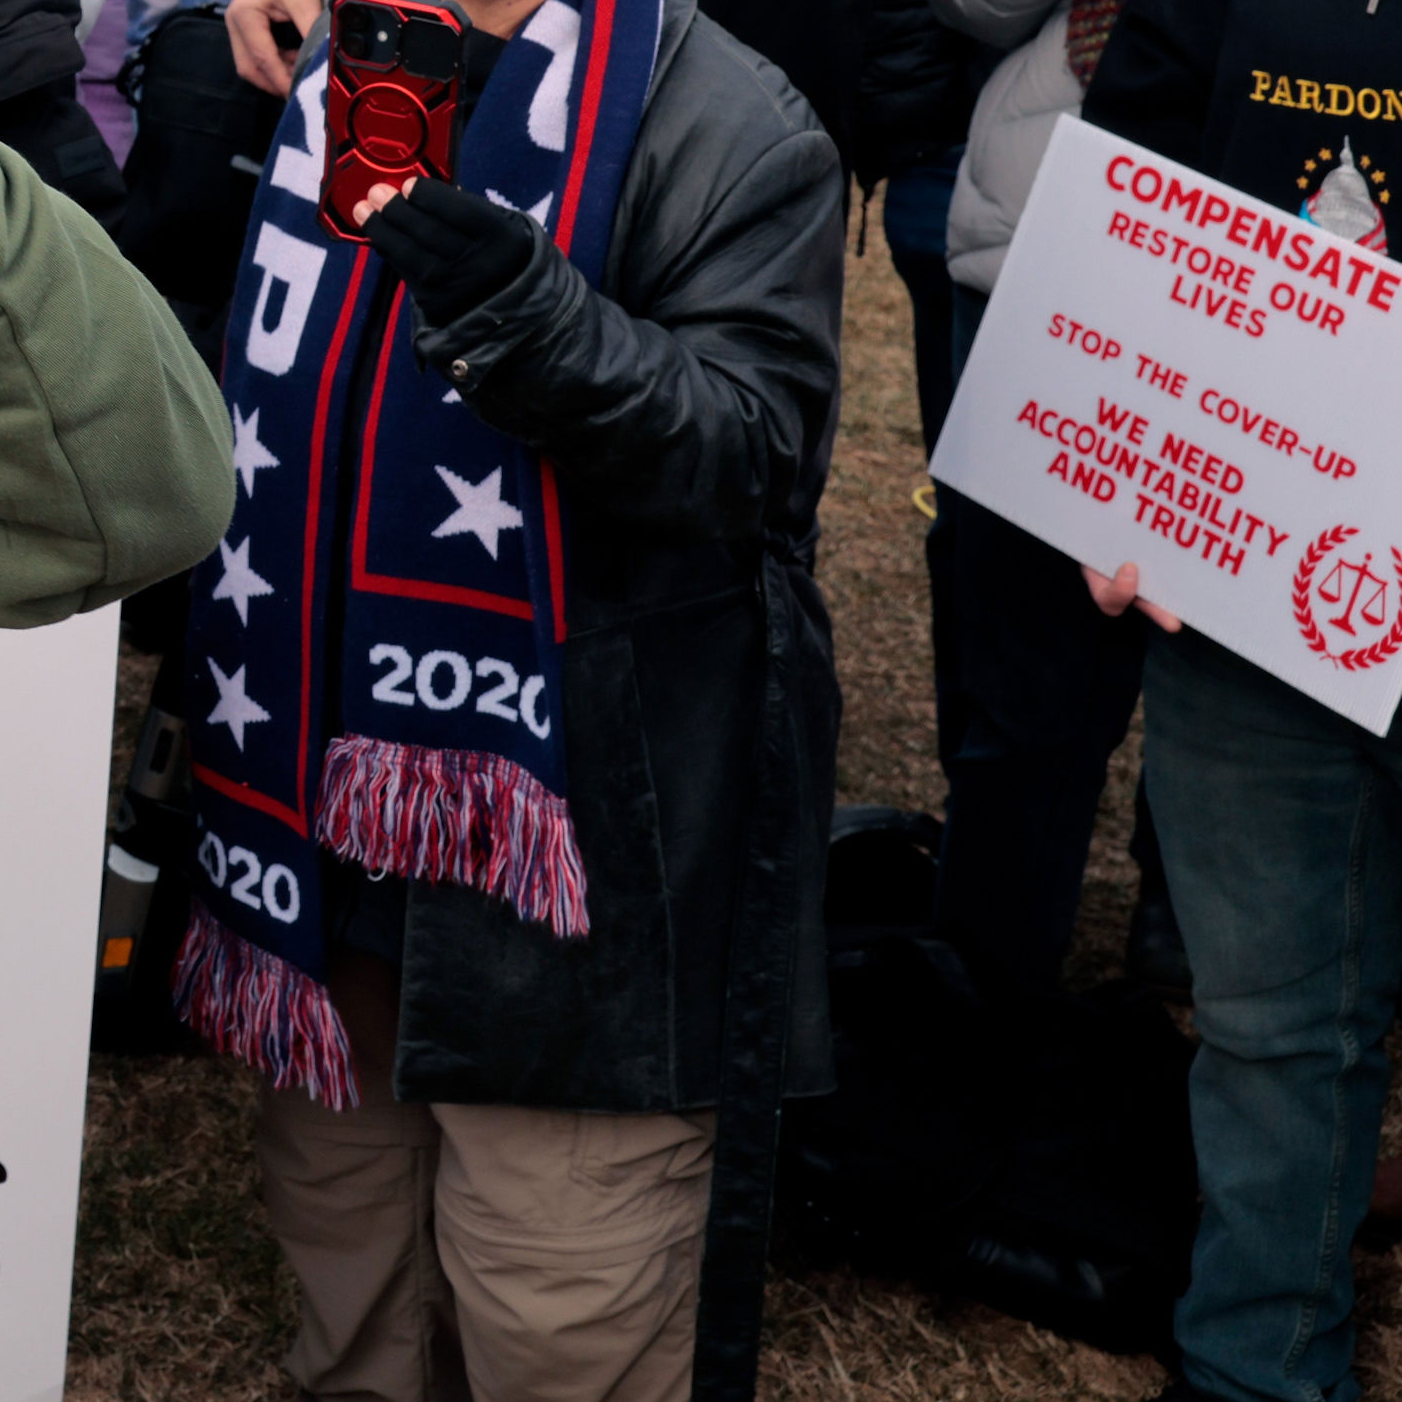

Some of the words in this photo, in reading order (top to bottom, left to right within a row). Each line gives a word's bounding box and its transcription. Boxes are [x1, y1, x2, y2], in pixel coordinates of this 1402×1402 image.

[1105, 155, 1402, 312] COMPENSATE
[1107, 211, 1256, 295] RESTORE
[1269, 282, 1345, 336] OUR
[1169, 274, 1268, 338] LIVES
[1048, 313, 1122, 361] STOP
[1135, 353, 1188, 399] THE
[1199, 388, 1357, 481] COVER-UP
[1097, 396, 1149, 446] WE
[1160, 432, 1244, 494] NEED
[1017, 400, 1290, 557] ACCOUNTABILITY
[1046, 451, 1117, 503] AND
[1134, 493, 1246, 577] TRUTH
[197, 813, 300, 924] 020
